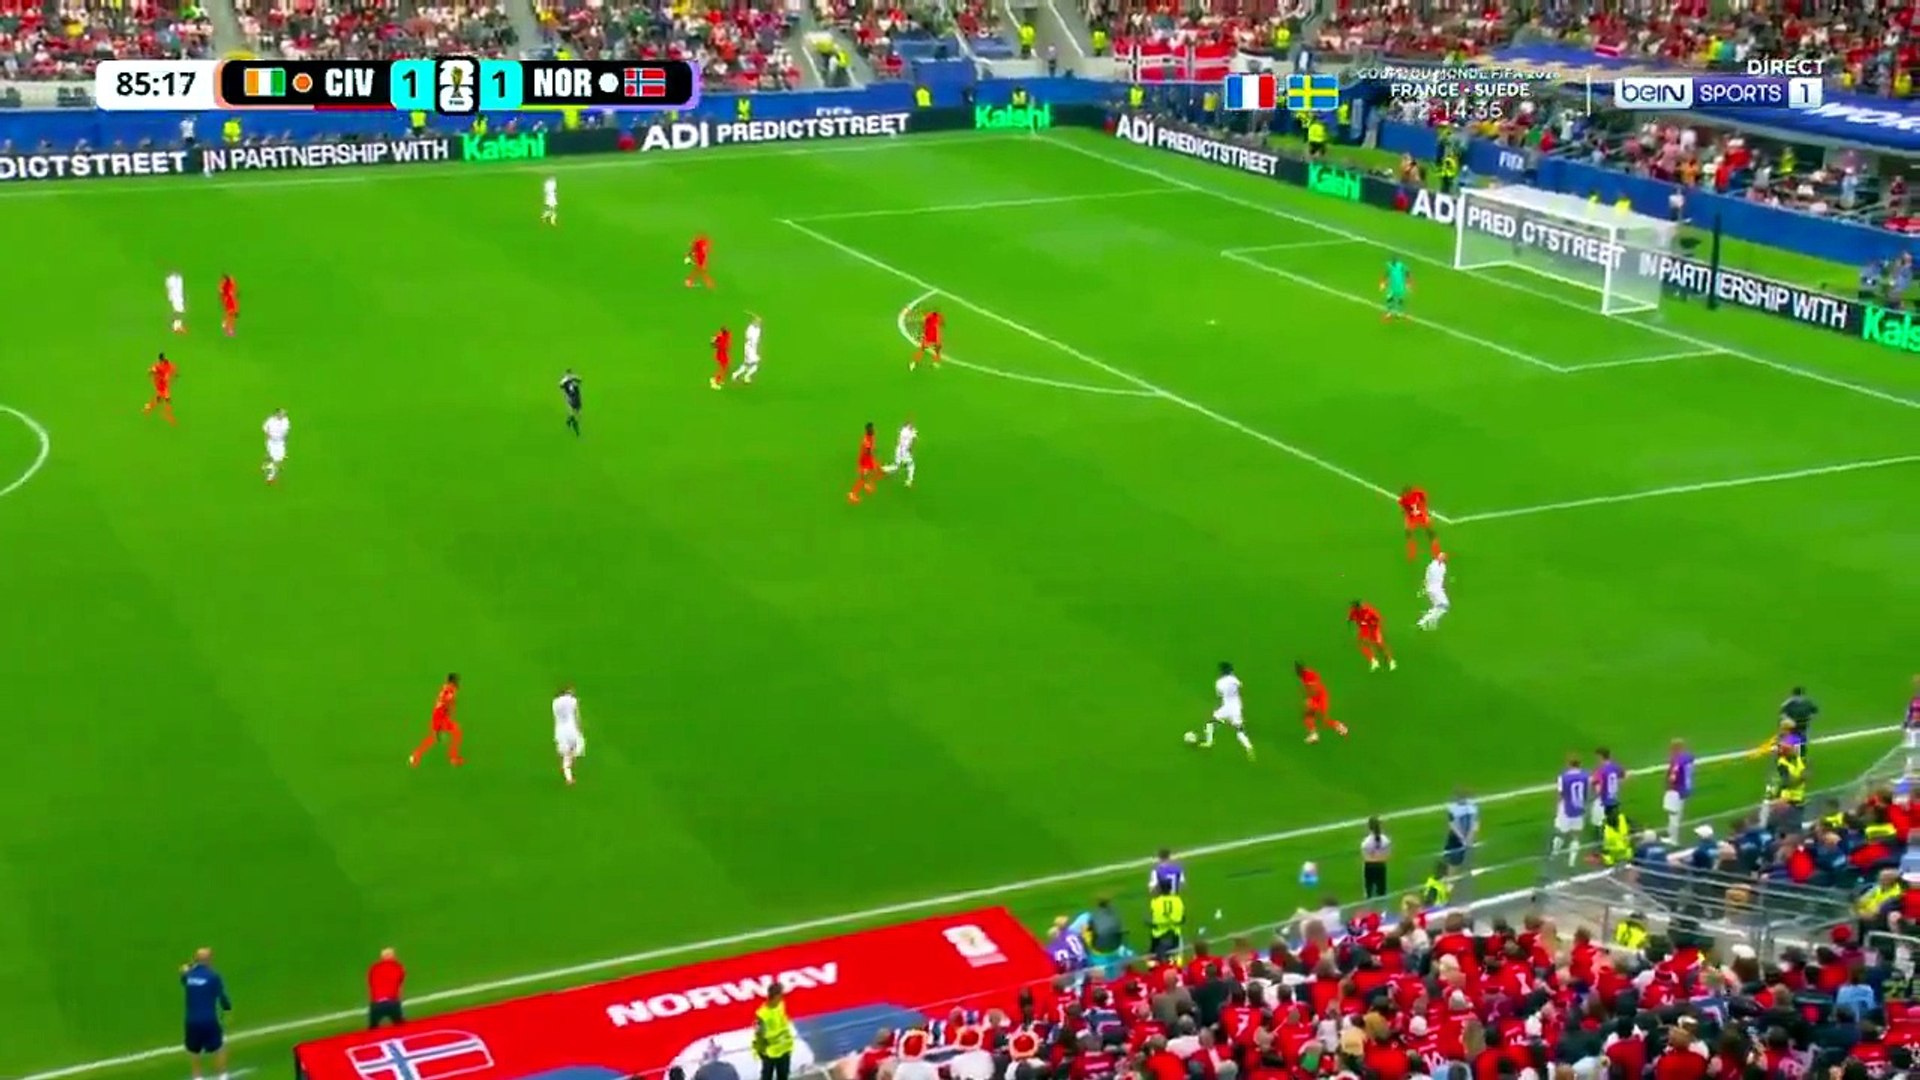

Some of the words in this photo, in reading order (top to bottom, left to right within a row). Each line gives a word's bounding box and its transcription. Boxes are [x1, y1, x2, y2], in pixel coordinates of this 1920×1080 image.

[641, 120, 709, 152] ADI
[716, 113, 910, 144] PREDICTSTREET
[975, 105, 1050, 129] Kalshi
[203, 149, 227, 175] IN
[230, 142, 388, 171] PARTNERSHIP
[391, 139, 449, 162] WITH
[462, 133, 547, 161] Kalshi
[1116, 114, 1155, 147] ADI
[1157, 126, 1279, 176] PREDICTSTREET
[1467, 206, 1627, 271] PREDCTSTREET
[1639, 251, 1657, 277] IN
[1792, 289, 1848, 329] WITH
[607, 961, 839, 1028] NORWAY
